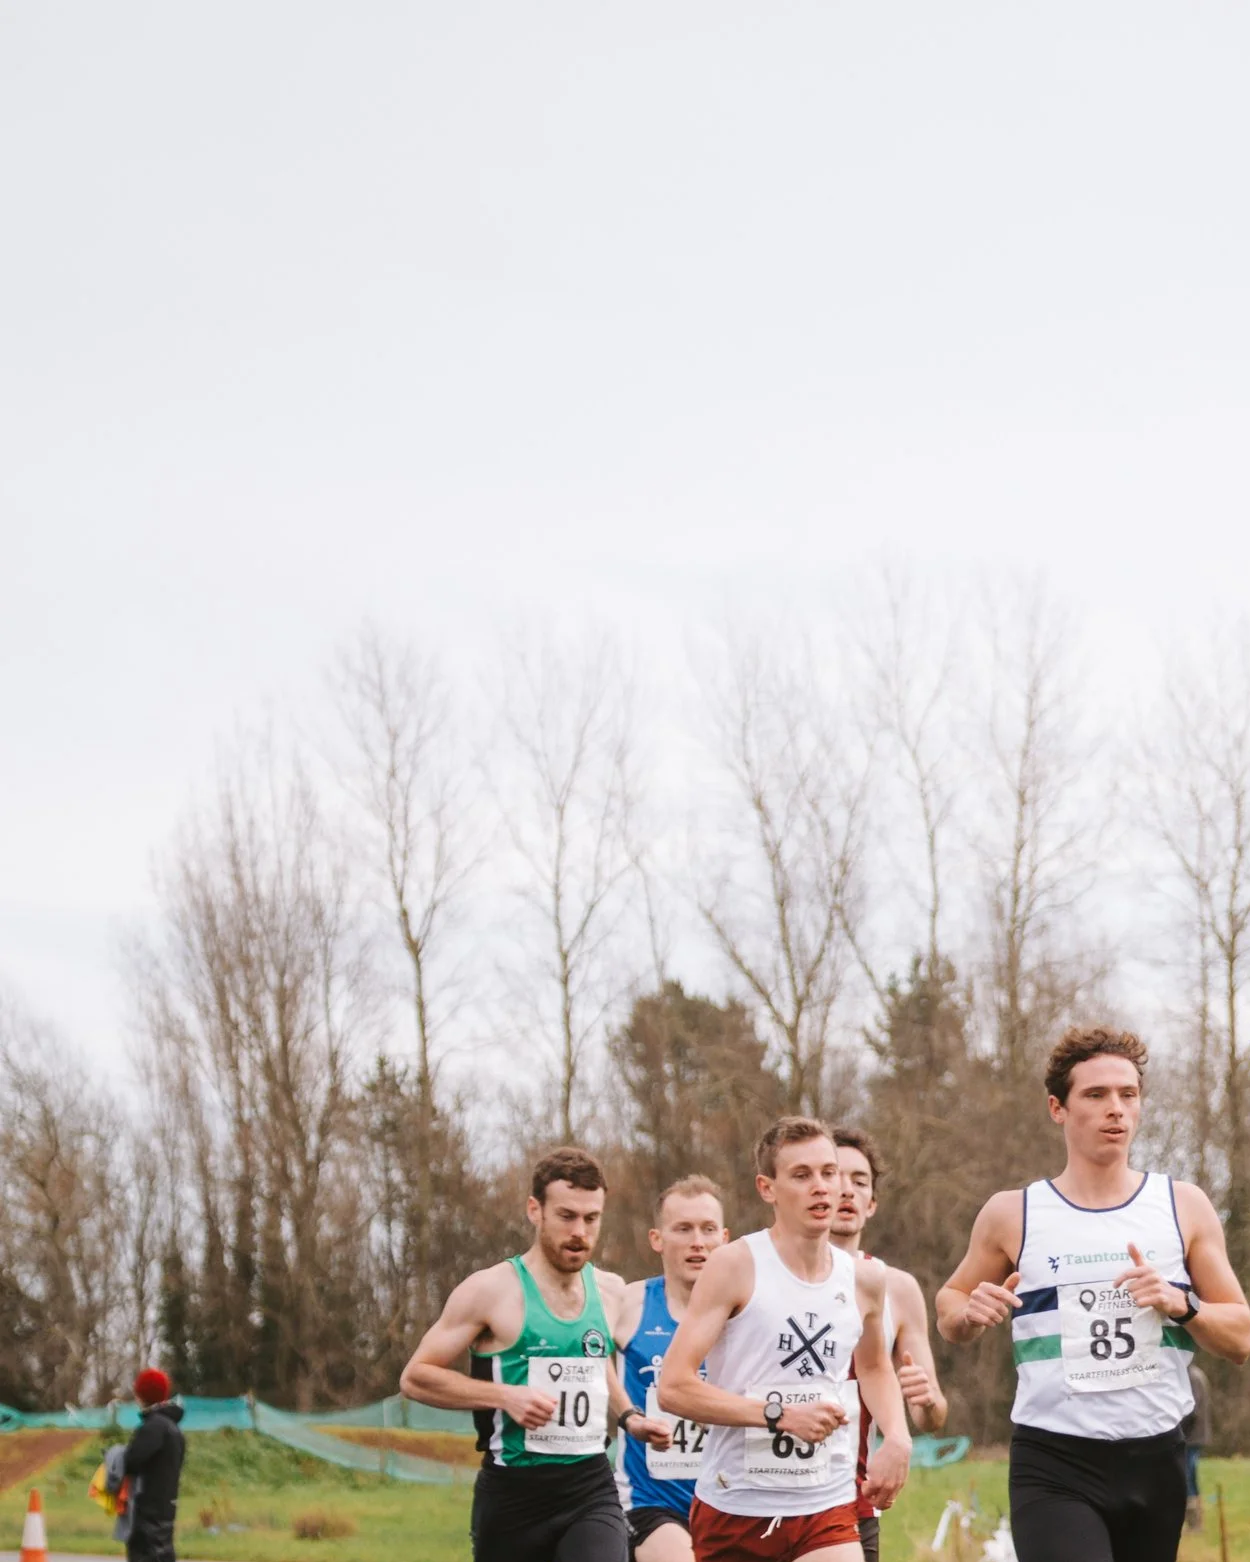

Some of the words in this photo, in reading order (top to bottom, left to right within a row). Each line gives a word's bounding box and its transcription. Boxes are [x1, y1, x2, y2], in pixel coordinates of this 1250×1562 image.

[1063, 1251, 1130, 1265] Taunton
[1099, 1289, 1132, 1301] STAR
[1098, 1300, 1138, 1310] FITNESS
[805, 1312, 818, 1329] T
[1090, 1317, 1136, 1361] 85
[785, 1393, 823, 1404] START
[558, 1391, 590, 1427] 10
